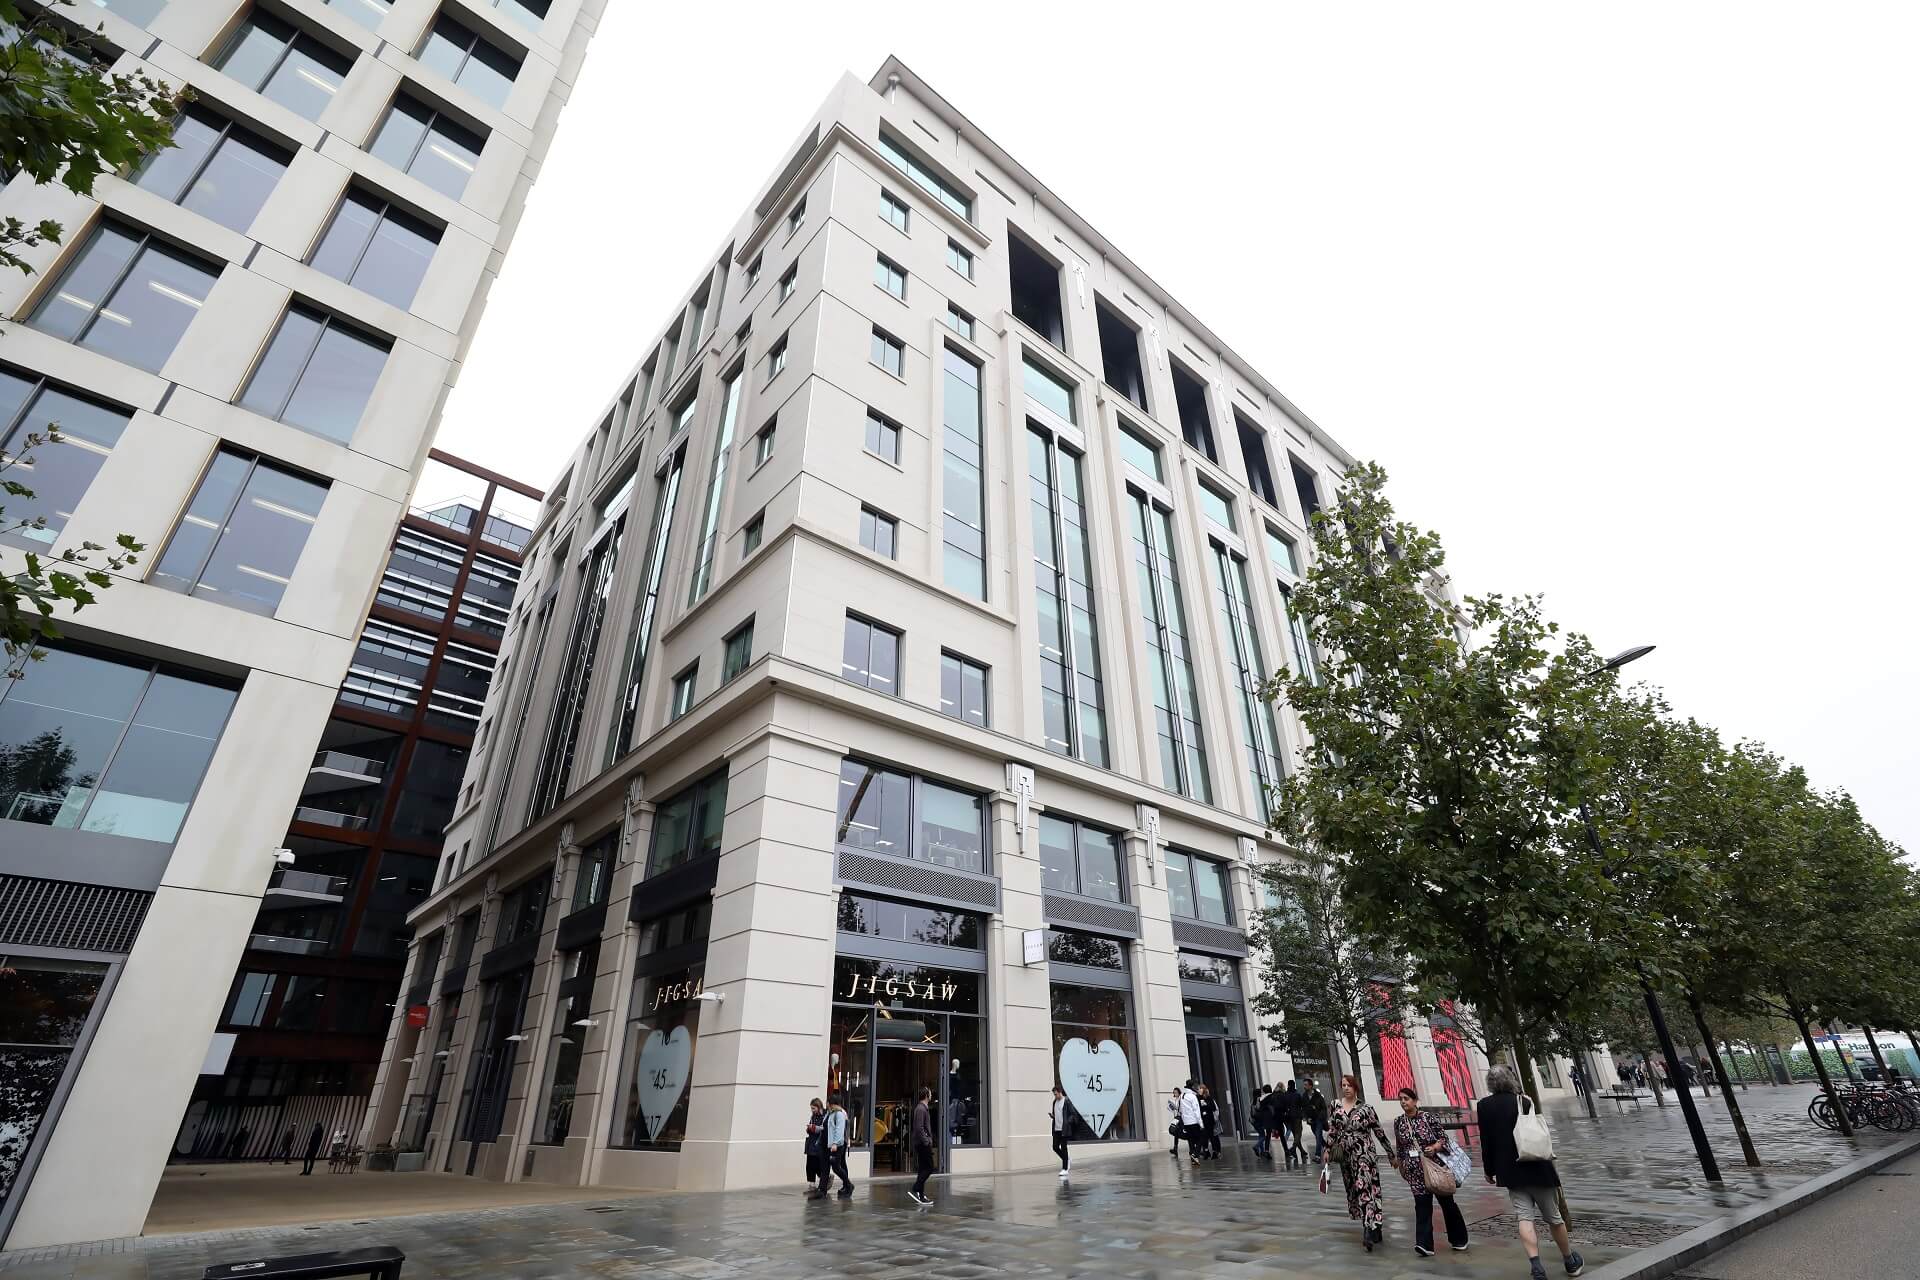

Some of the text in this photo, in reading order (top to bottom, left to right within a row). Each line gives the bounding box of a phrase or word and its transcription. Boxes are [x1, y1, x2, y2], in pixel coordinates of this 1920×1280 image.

[846, 974, 958, 1001] JIGSAW
[1848, 1042, 1896, 1050] Hanon
[653, 1069, 667, 1090] 45
[1087, 1074, 1103, 1092] 45
[650, 1115, 661, 1137] 17
[1091, 1114, 1105, 1133] 17
